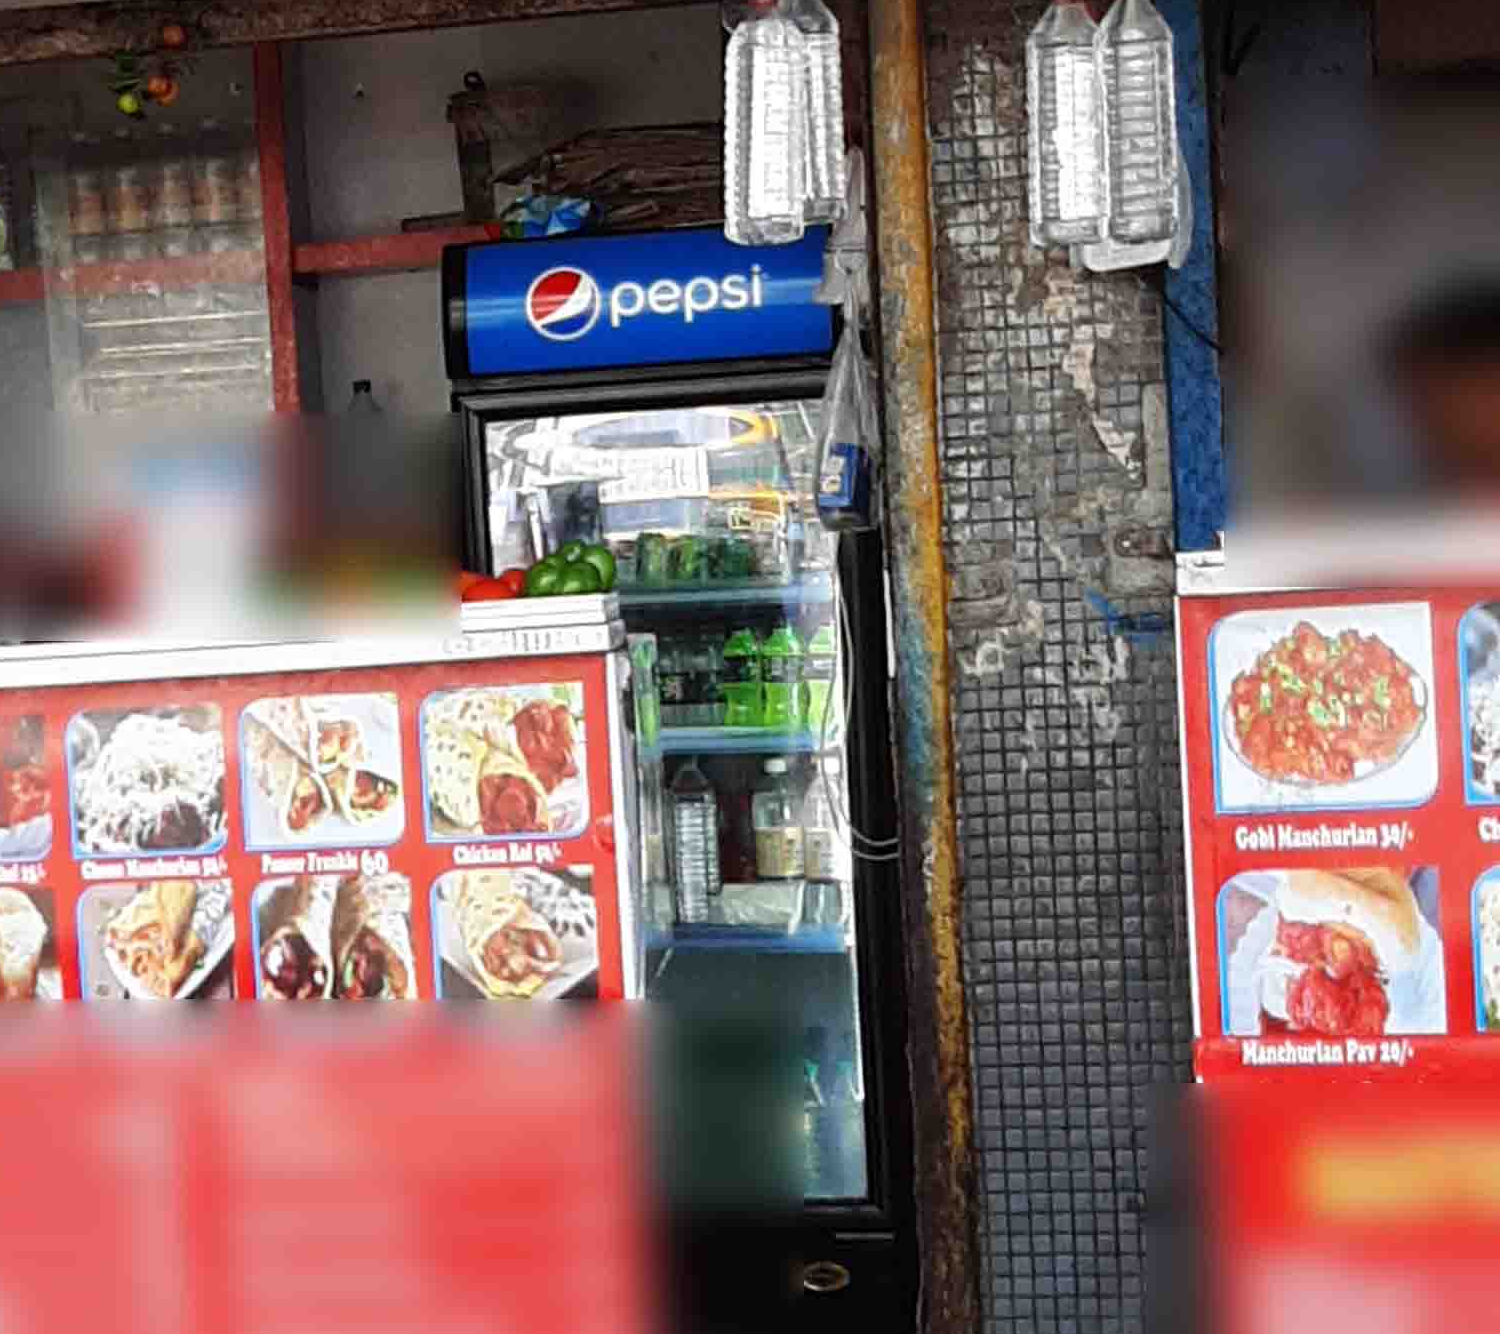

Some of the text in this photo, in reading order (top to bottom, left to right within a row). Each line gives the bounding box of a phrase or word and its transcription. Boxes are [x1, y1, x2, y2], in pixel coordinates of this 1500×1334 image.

[610, 264, 764, 328] pepsi
[1235, 825, 1275, 850] Gobi
[1277, 823, 1377, 849] Manchurian
[1241, 1039, 1343, 1066] Manchurian
[1346, 1038, 1377, 1063] Pav
